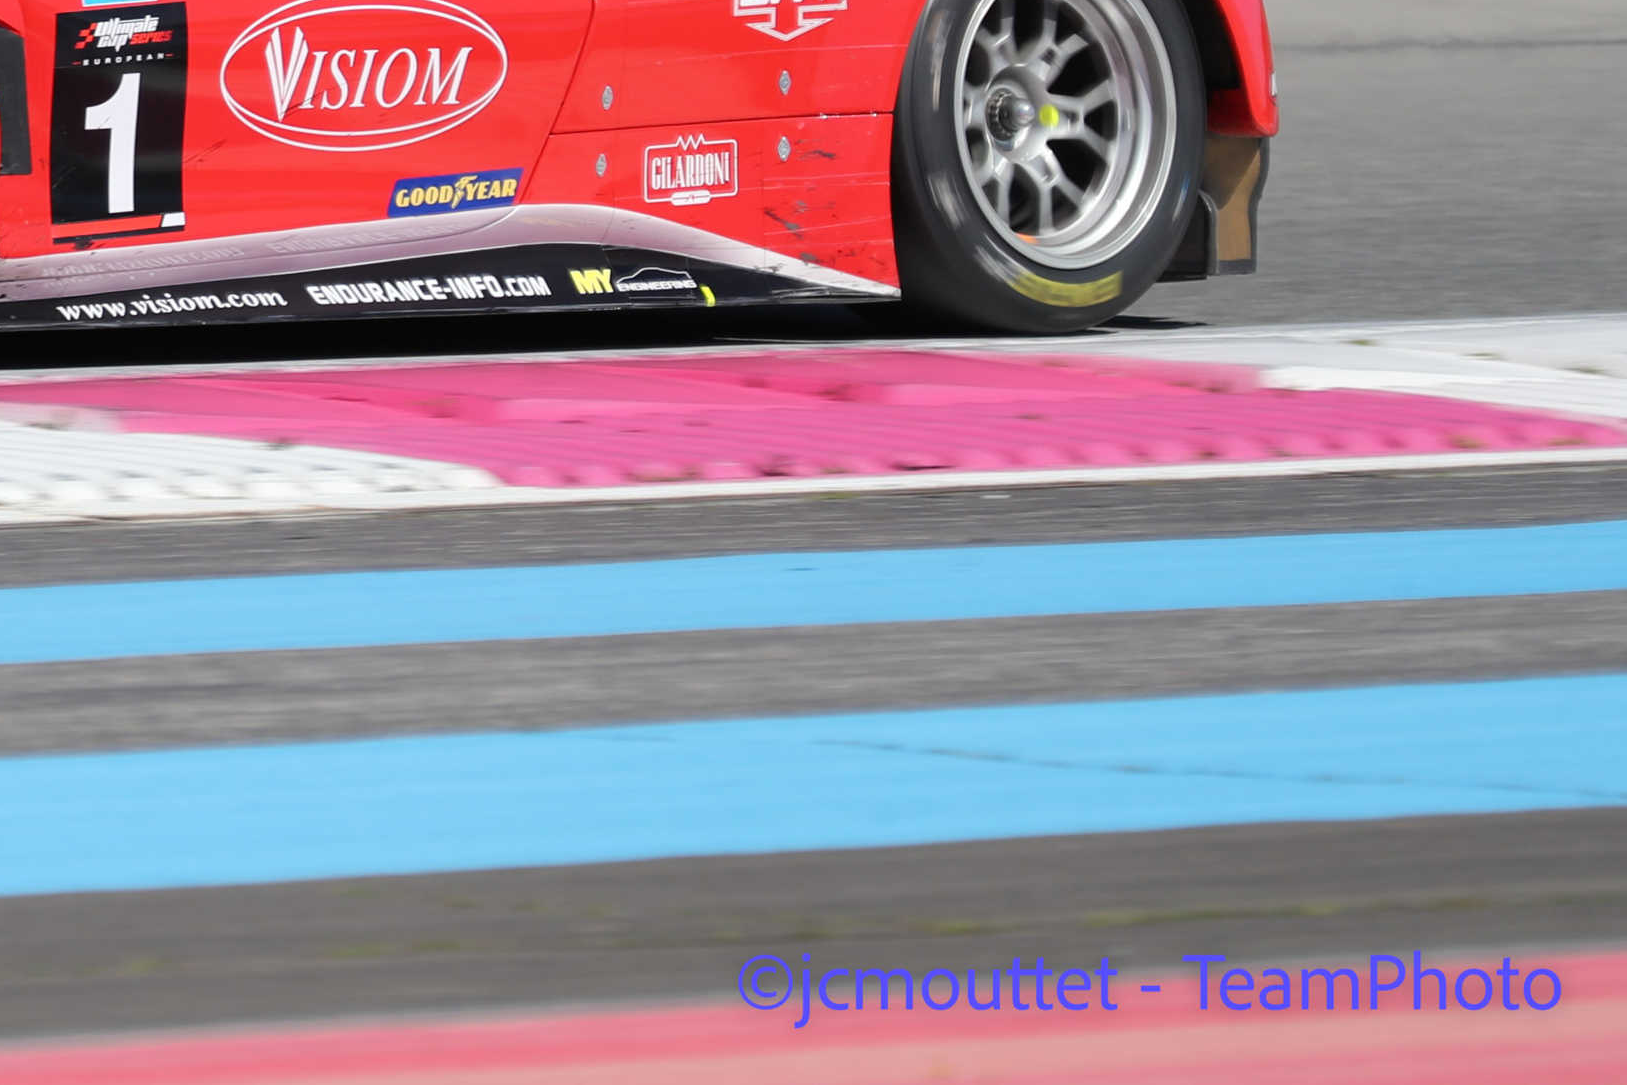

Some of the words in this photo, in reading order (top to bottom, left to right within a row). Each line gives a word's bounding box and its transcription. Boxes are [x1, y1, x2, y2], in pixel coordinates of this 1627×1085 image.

[82, 52, 165, 66] EUROPEAN
[264, 26, 474, 123] VISIOM
[84, 72, 141, 214] 1
[651, 151, 731, 190] GILARDONI
[306, 275, 552, 305] ENDURANCE-INFO.COM
[569, 268, 614, 294] MY
[615, 279, 698, 292] ENGINEERING
[56, 288, 288, 322] www.visiom.com
